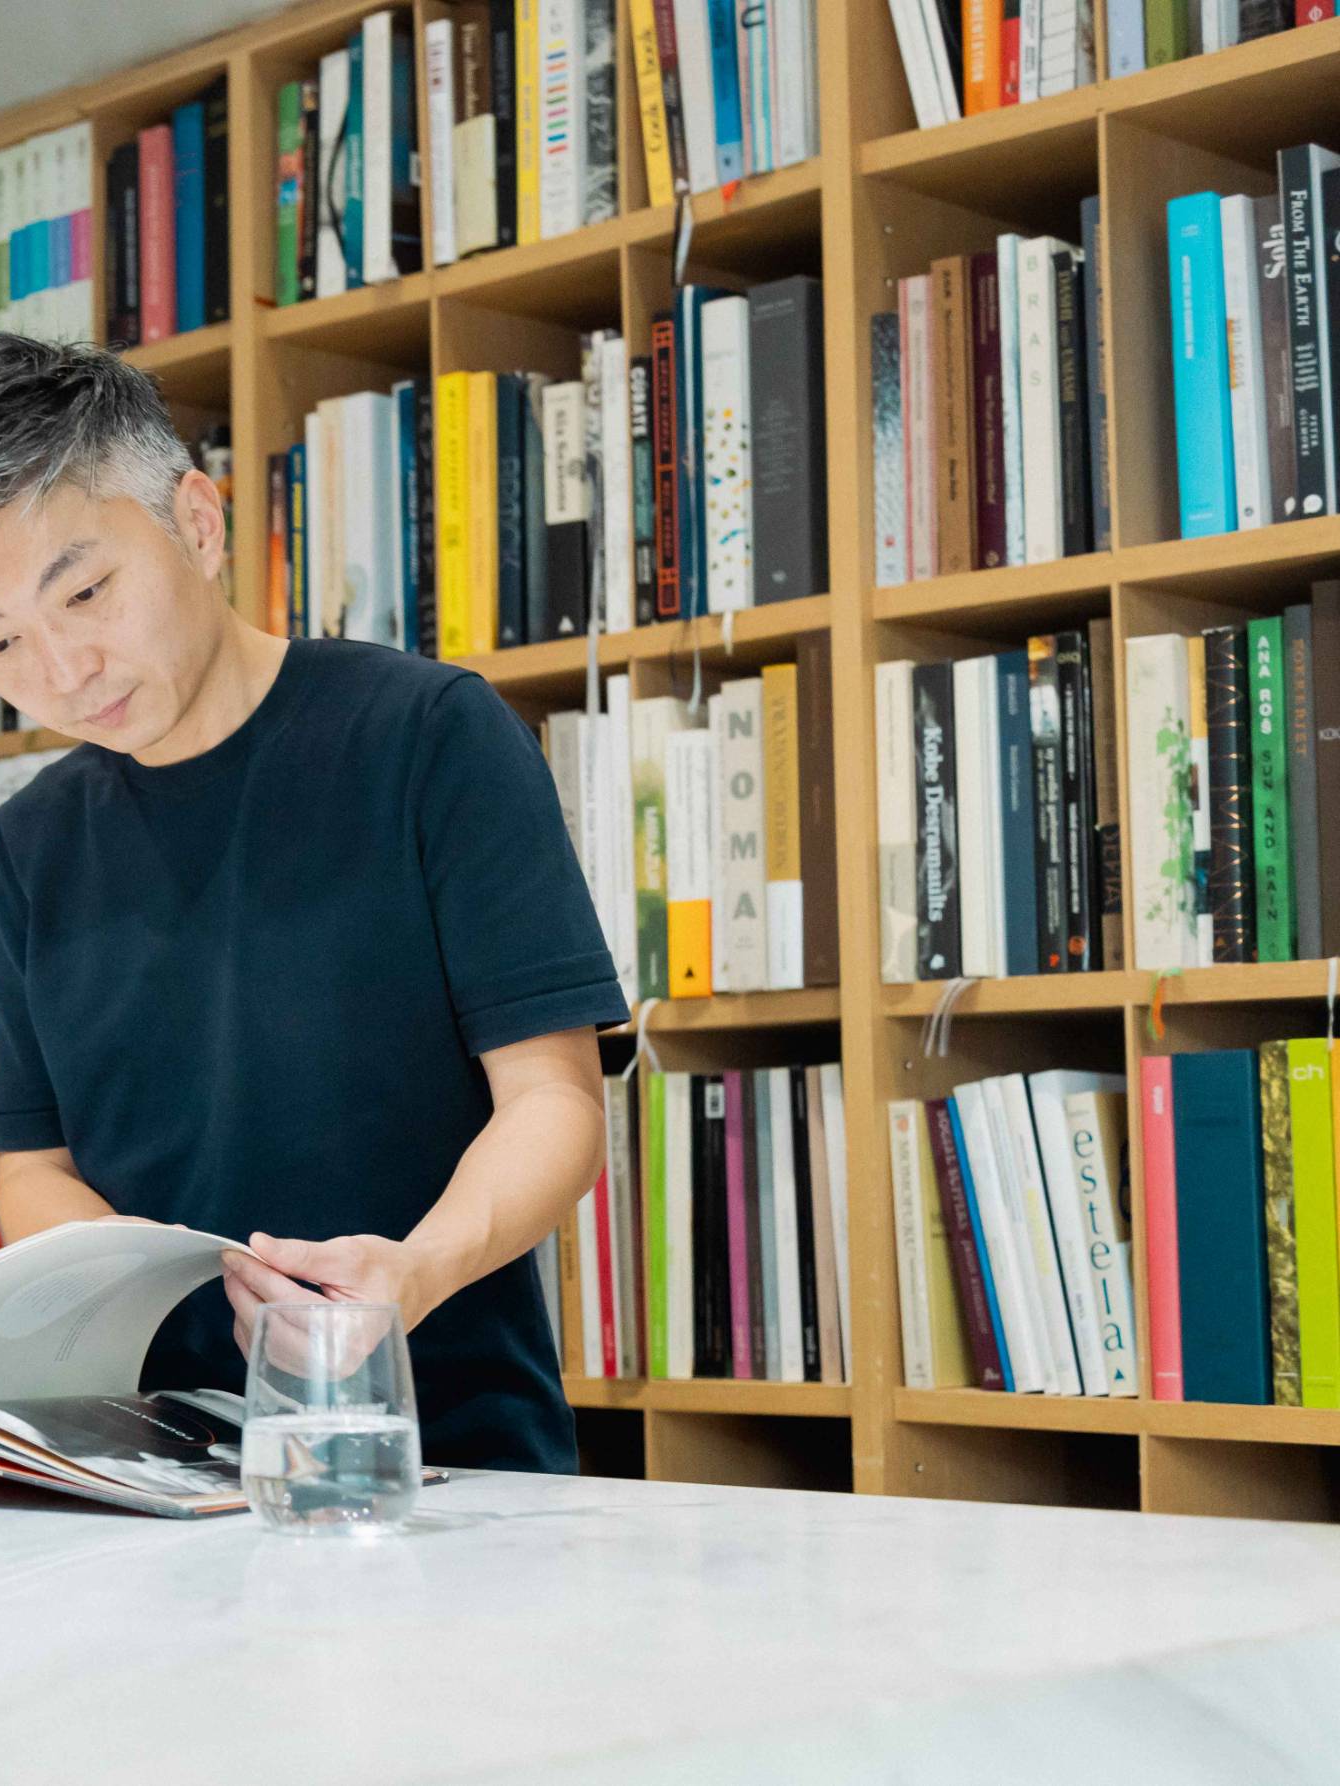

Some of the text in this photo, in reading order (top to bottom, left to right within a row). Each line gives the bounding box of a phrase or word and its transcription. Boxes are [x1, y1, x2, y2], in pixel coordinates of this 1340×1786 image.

[1289, 189, 1313, 327] FROM THE EARTH
[1257, 635, 1272, 677] ANA
[728, 709, 758, 920] NOMA
[923, 726, 949, 922] Kobe Desramaults
[1263, 807, 1278, 849] AND
[1265, 866, 1278, 922] RAIN
[1073, 1129, 1125, 1352] estela
